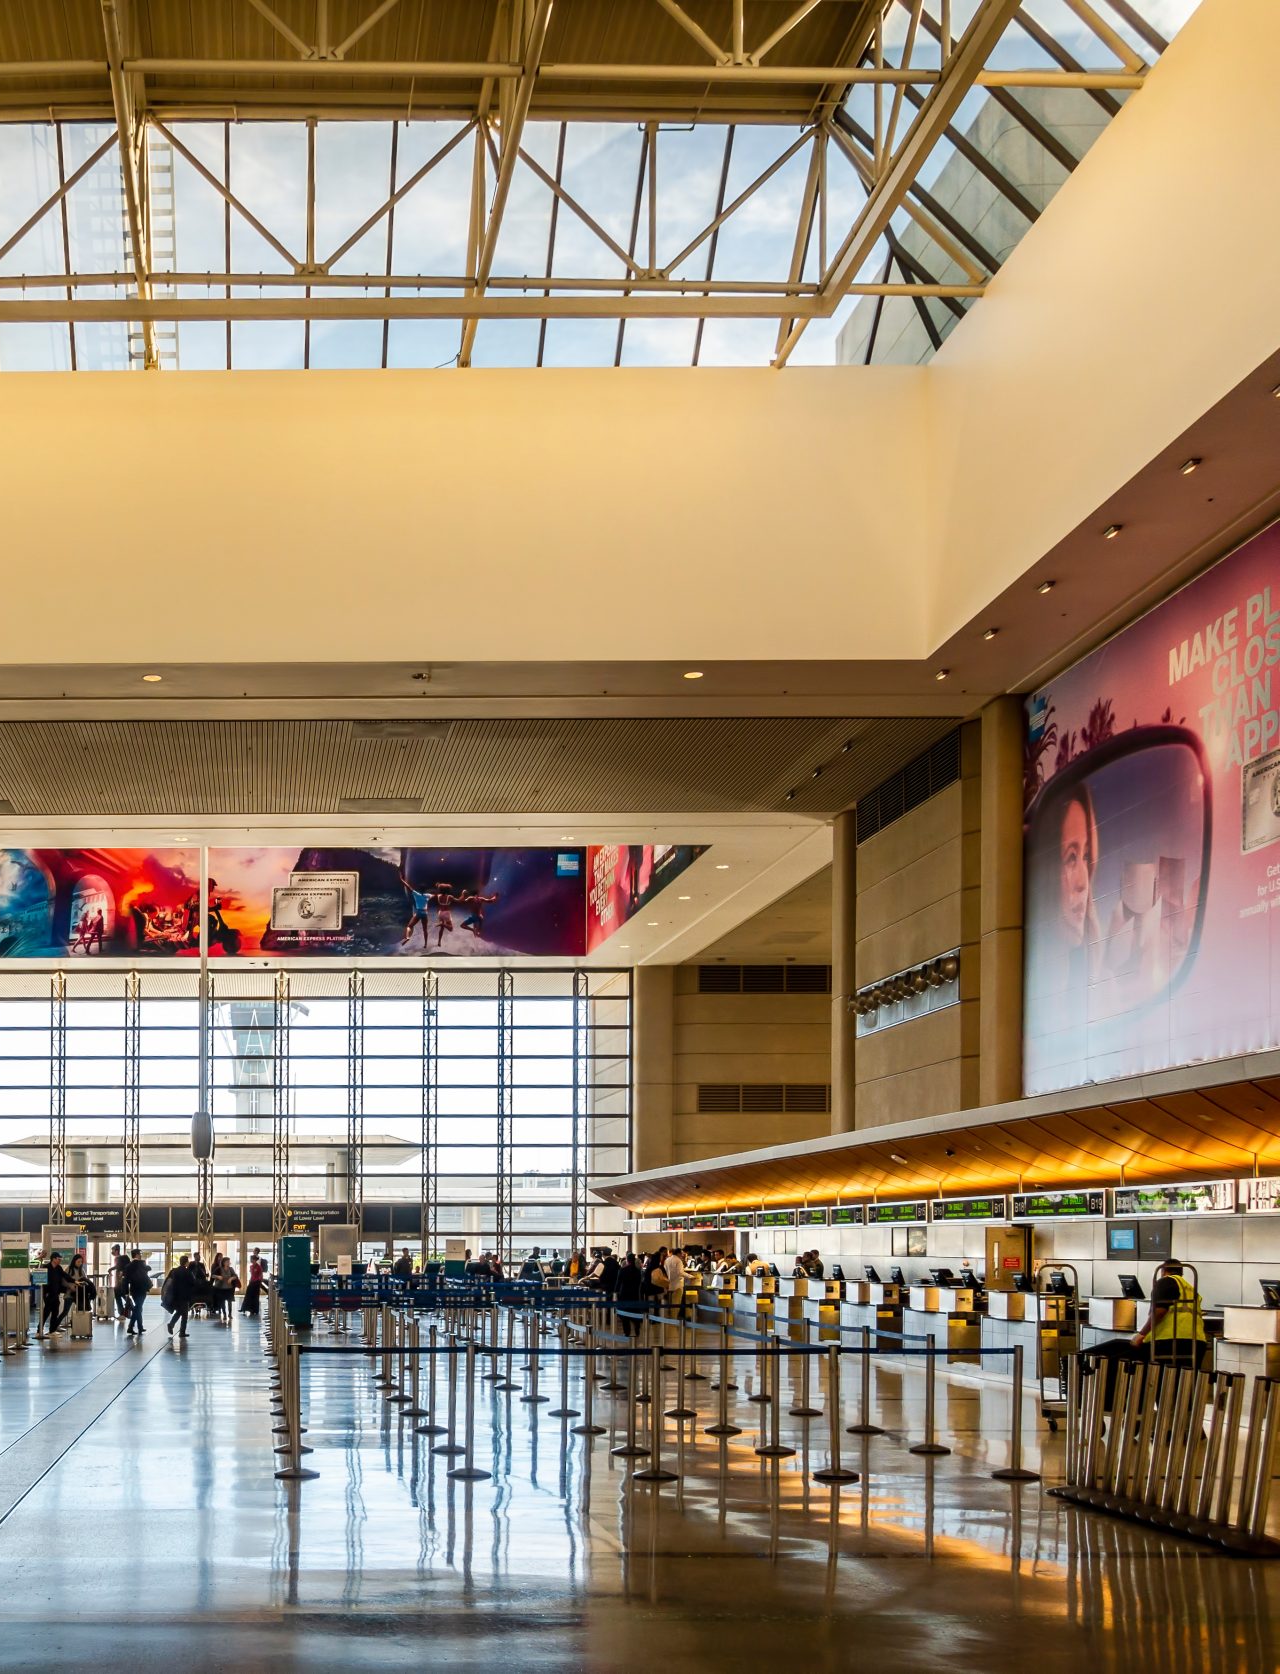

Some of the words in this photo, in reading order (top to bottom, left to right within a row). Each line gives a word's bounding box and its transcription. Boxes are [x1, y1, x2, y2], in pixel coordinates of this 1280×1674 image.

[1168, 606, 1238, 686] MAKE
[1199, 670, 1271, 743] THAN
[1224, 709, 1280, 772] APP
[1014, 1202, 1024, 1213] B18
[1090, 1198, 1102, 1211] B19
